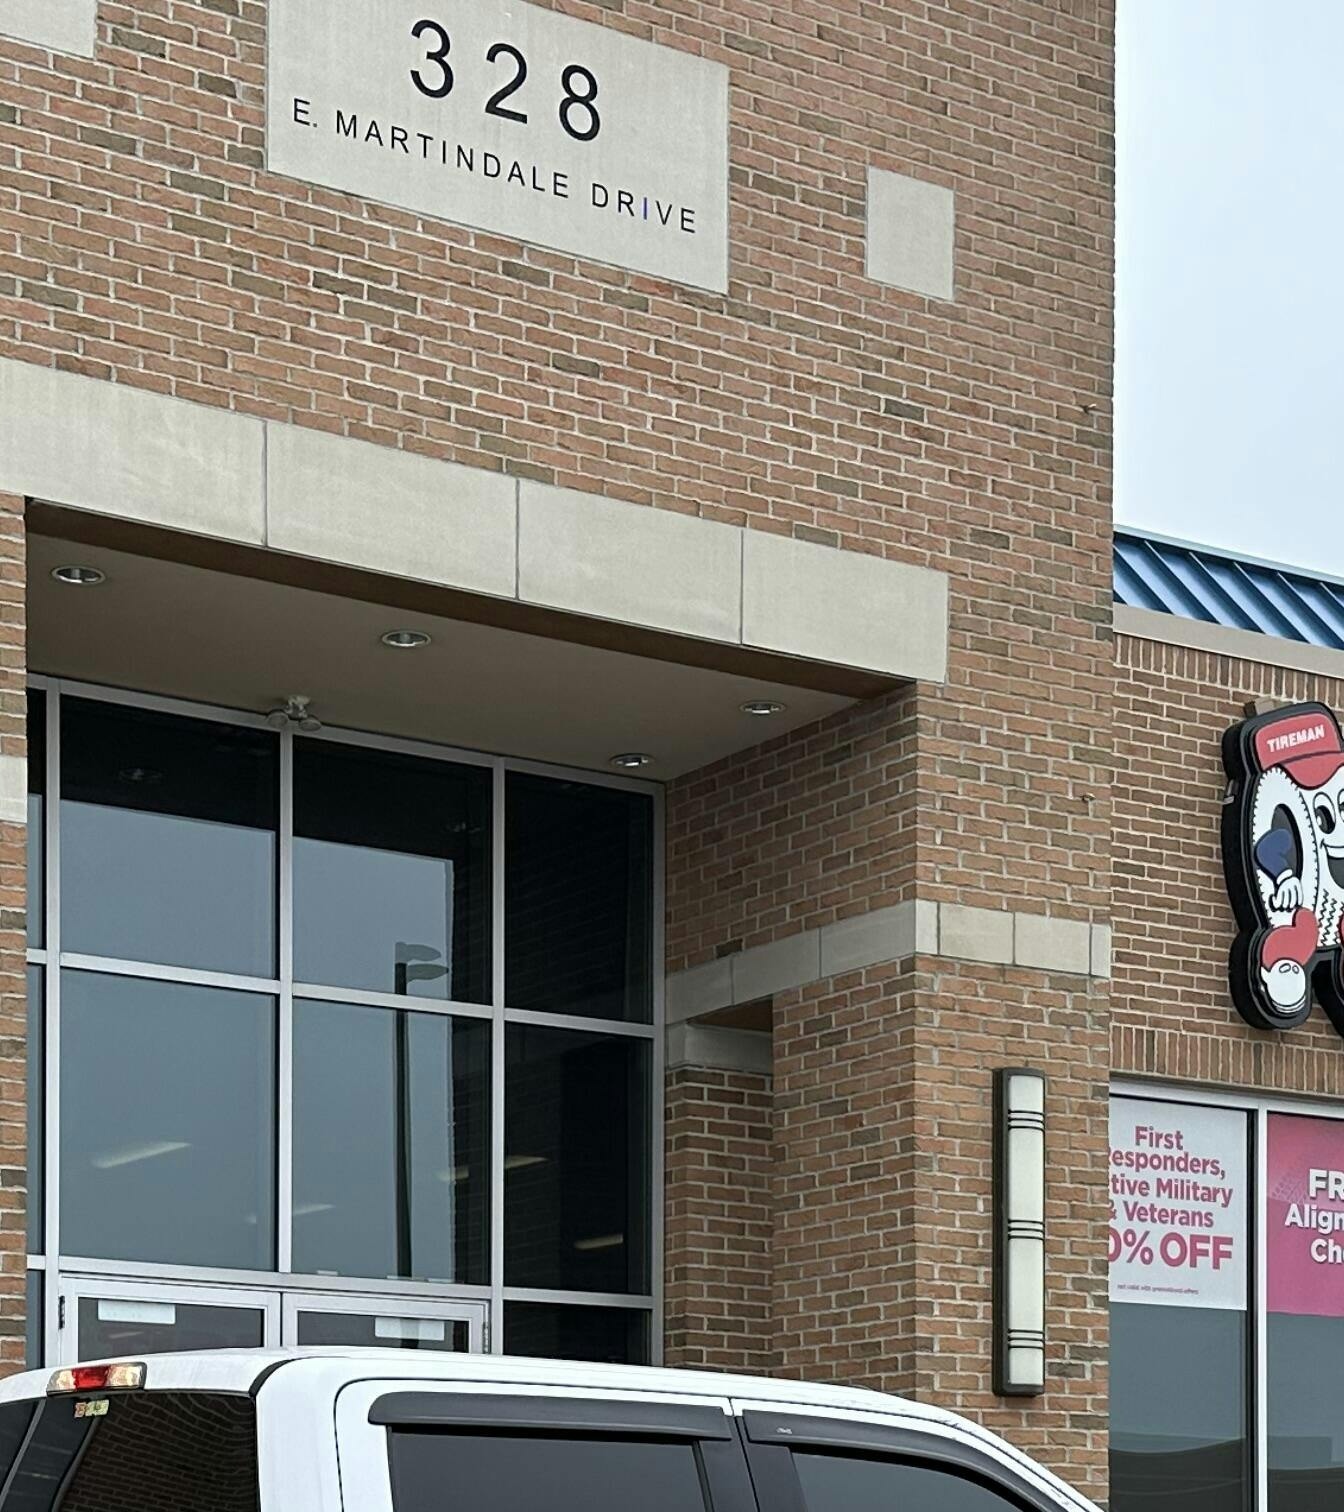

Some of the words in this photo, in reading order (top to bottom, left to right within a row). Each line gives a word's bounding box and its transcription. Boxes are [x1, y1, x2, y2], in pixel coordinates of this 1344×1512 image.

[409, 19, 601, 142] 328
[293, 98, 318, 128] E.
[335, 110, 569, 198] MARTINDALE
[592, 183, 696, 234] DRIVE
[1267, 724, 1325, 753] TIREMAN
[1135, 1125, 1183, 1151] First
[1109, 1147, 1226, 1180] esponders,
[1111, 1173, 1150, 1197] tive
[1156, 1177, 1233, 1208] Military
[1123, 1200, 1214, 1228] Veterans
[1159, 1231, 1234, 1270] OFF
